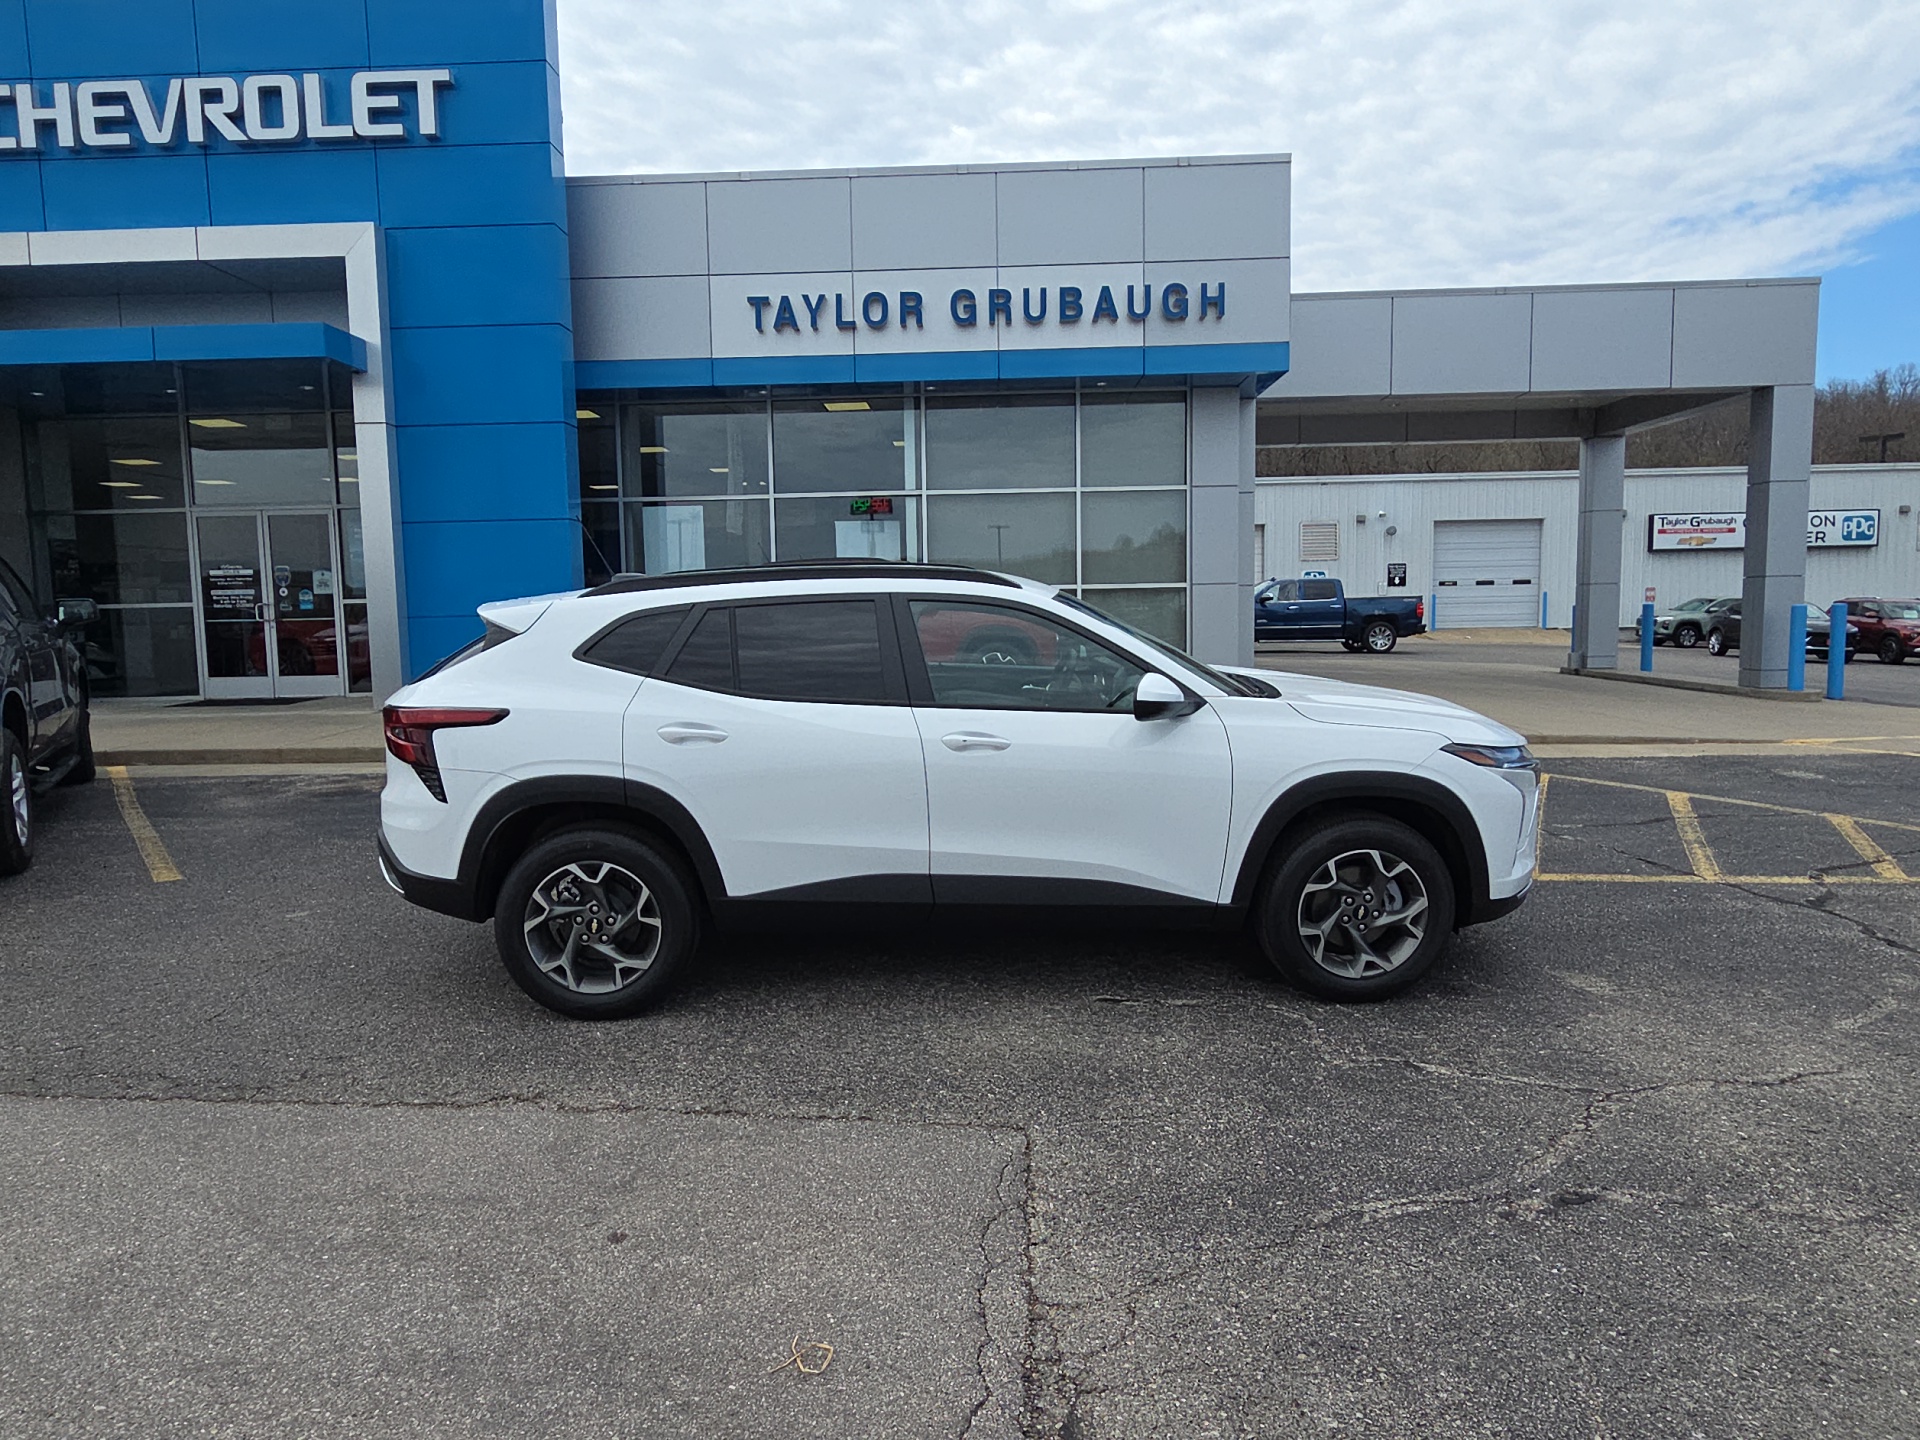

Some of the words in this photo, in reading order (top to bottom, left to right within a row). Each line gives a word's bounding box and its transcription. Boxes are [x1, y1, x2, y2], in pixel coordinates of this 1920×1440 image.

[747, 291, 924, 333] TAYLOR
[950, 282, 1226, 326] GRUBAUGH
[1658, 516, 1689, 528] Taylor
[1690, 516, 1737, 527] Grubaugh
